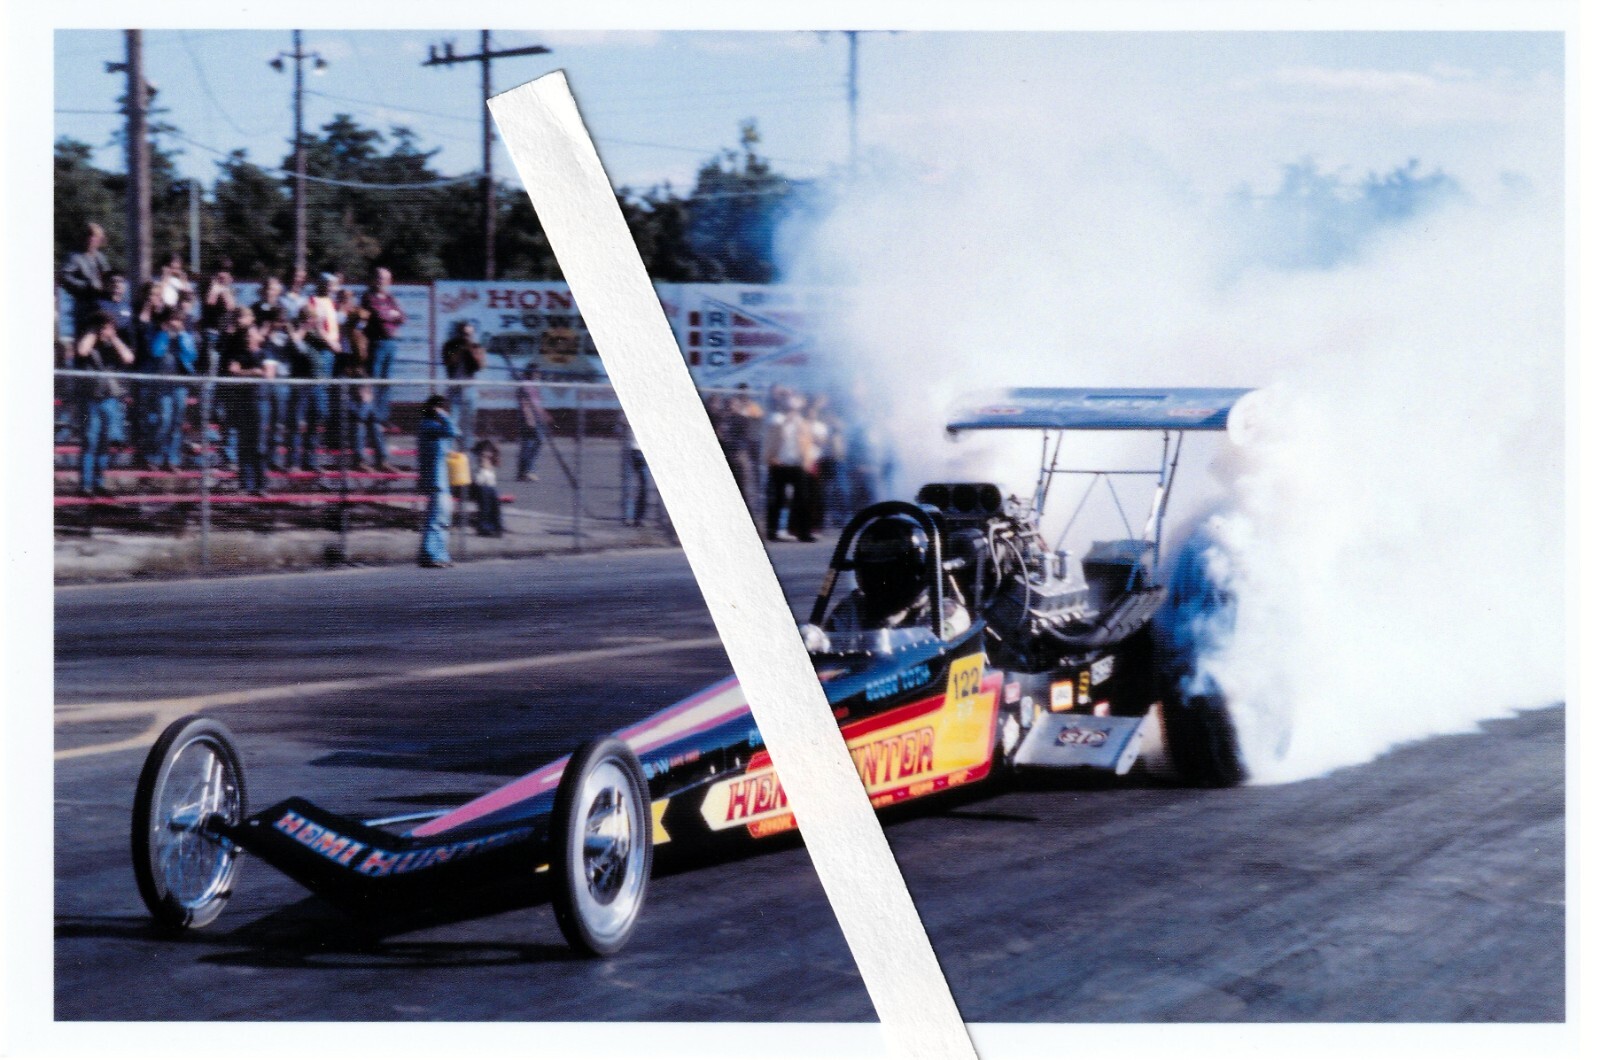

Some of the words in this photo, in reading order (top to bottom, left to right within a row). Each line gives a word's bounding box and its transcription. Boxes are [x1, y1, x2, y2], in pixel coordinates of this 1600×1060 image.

[953, 666, 979, 700] 122
[1059, 728, 1107, 747] STP
[273, 811, 364, 868] HEMI
